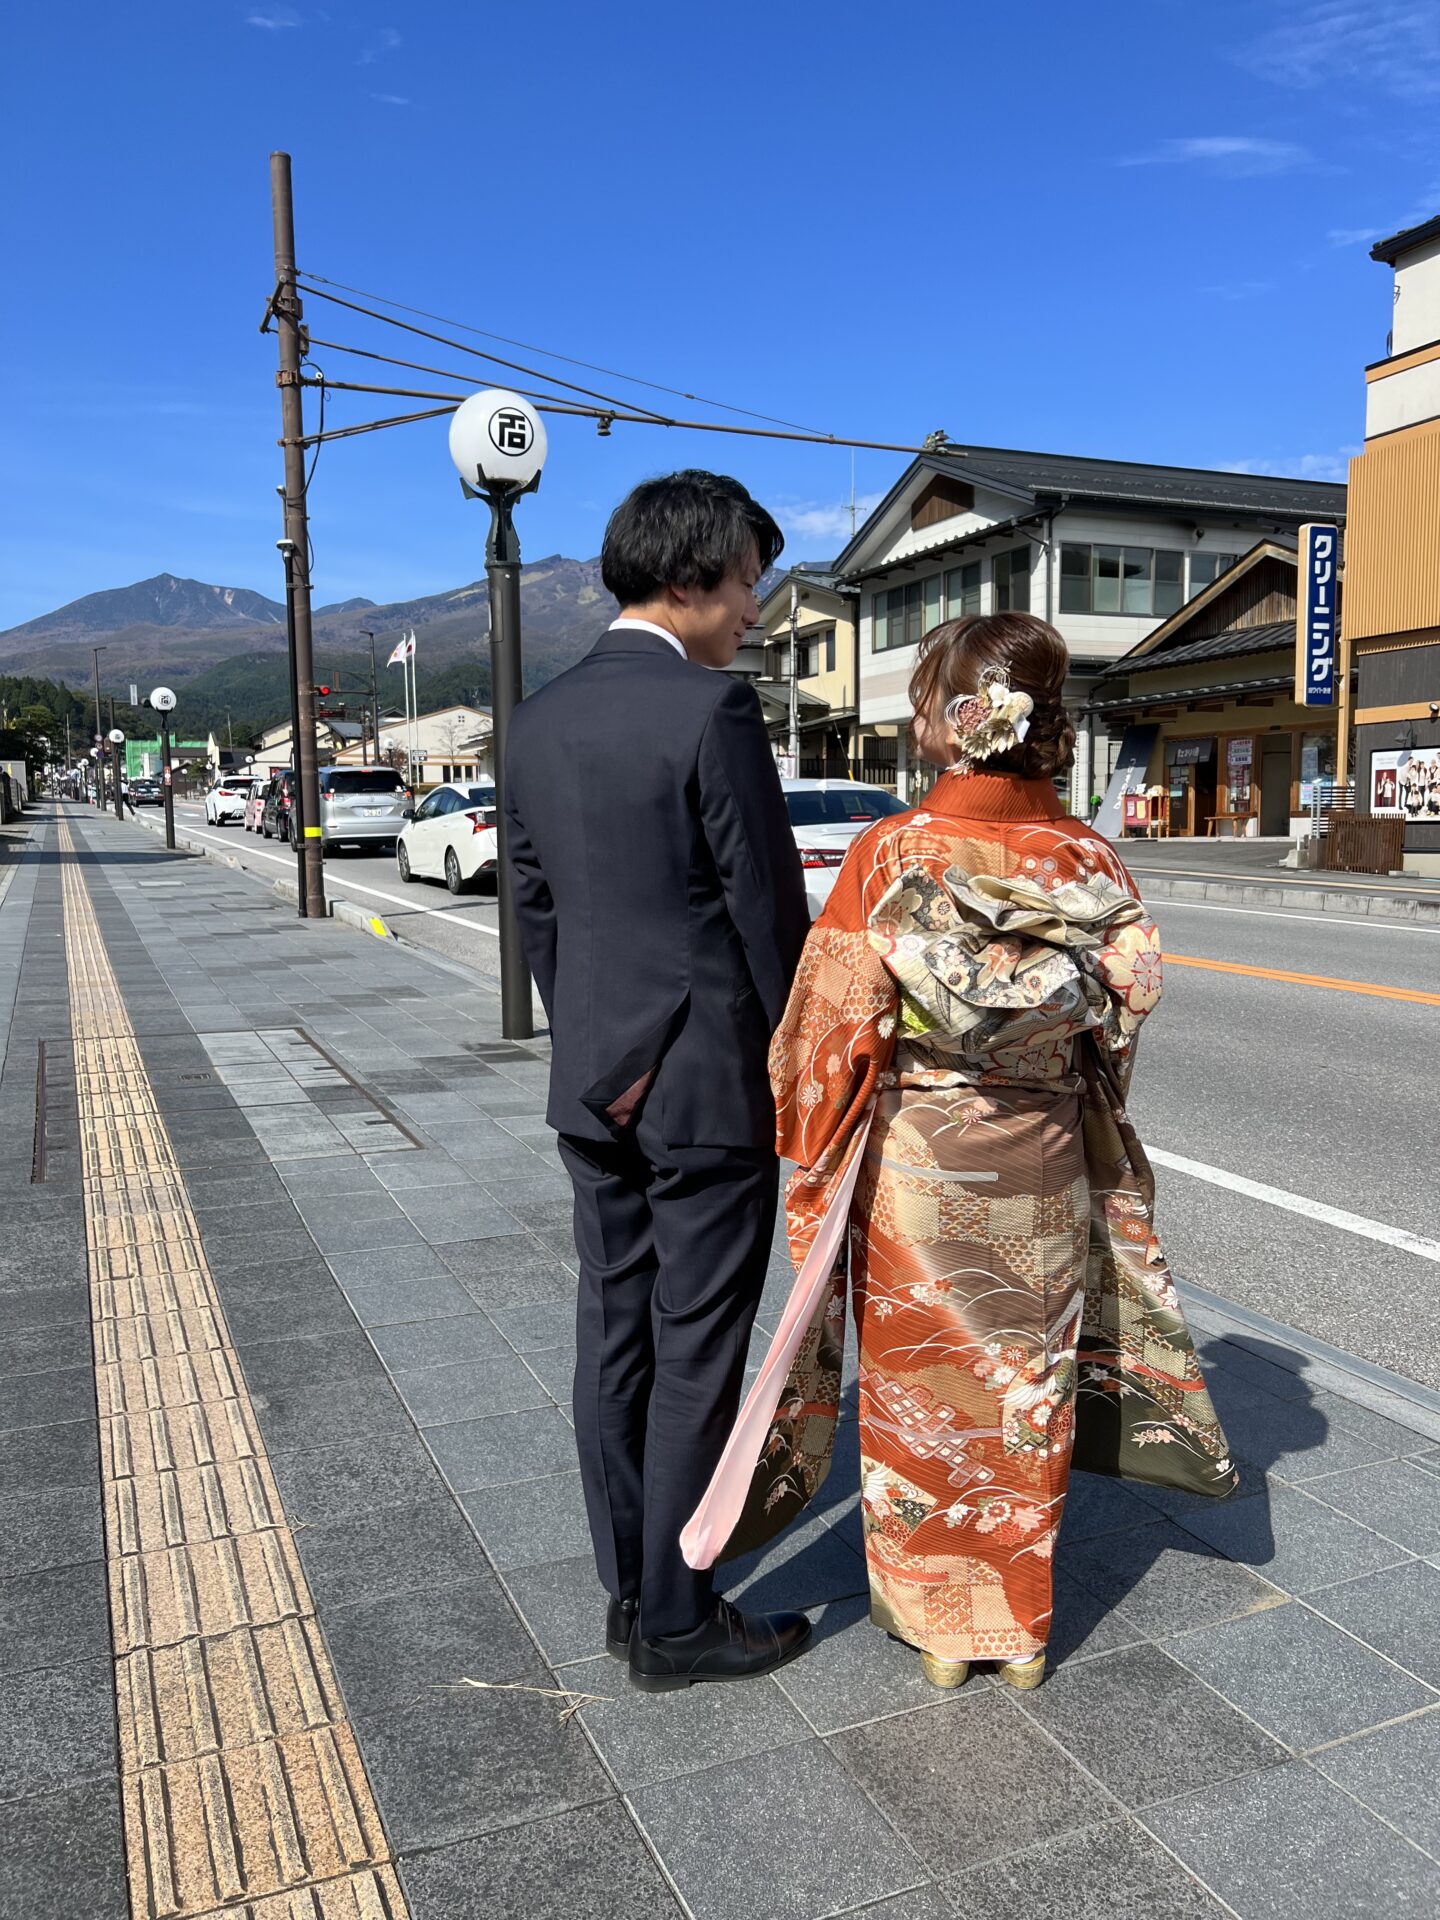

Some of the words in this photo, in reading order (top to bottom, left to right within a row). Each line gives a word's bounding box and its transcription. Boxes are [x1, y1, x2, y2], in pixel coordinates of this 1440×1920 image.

[1311, 534, 1333, 682] クリーニング
